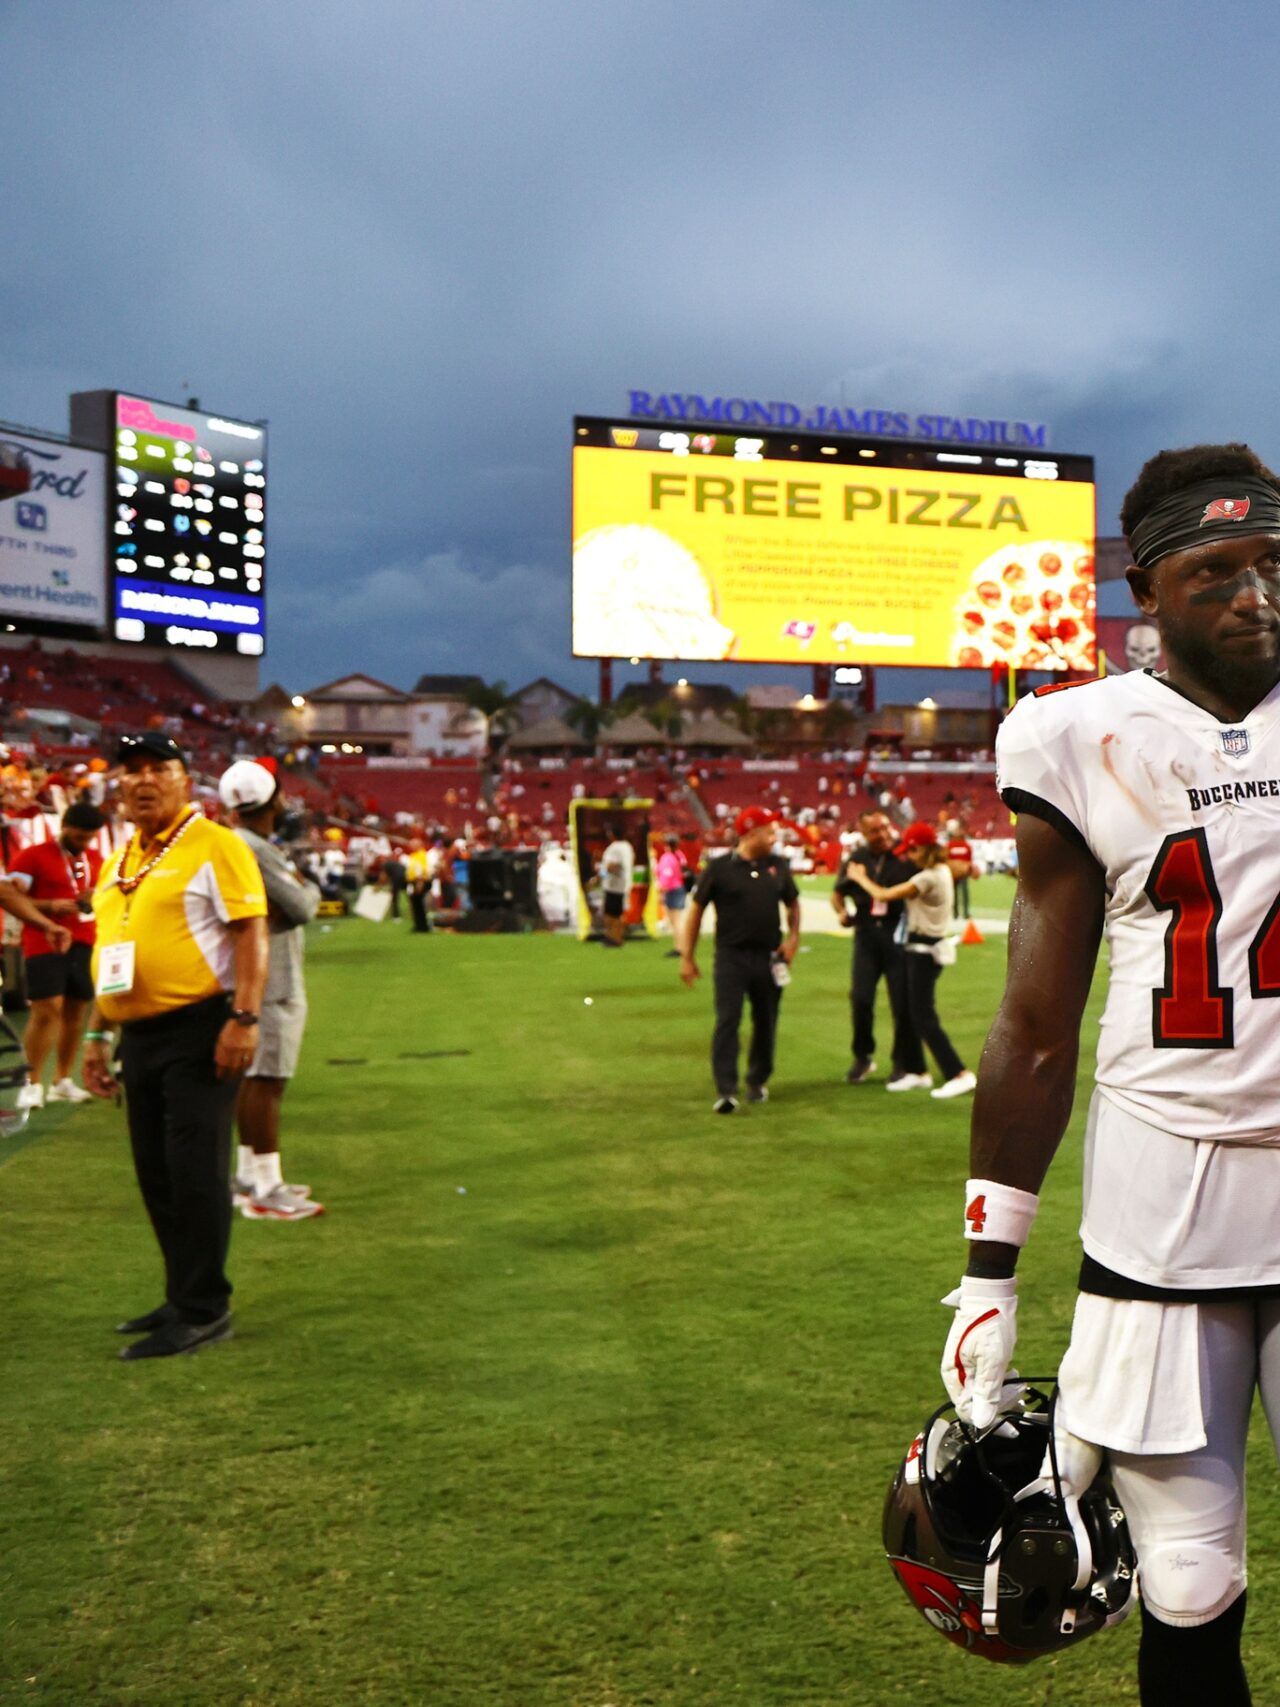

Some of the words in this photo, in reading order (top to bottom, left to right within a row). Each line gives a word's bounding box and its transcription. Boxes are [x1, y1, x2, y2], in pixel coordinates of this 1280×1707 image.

[629, 390, 801, 427] RAYMOND
[805, 404, 910, 437] JAMES
[917, 413, 1046, 447] STADIUM
[650, 471, 822, 519] FREE
[844, 484, 1029, 532] PIZZA
[1226, 738, 1247, 751] NFL
[966, 1194, 987, 1233] 4
